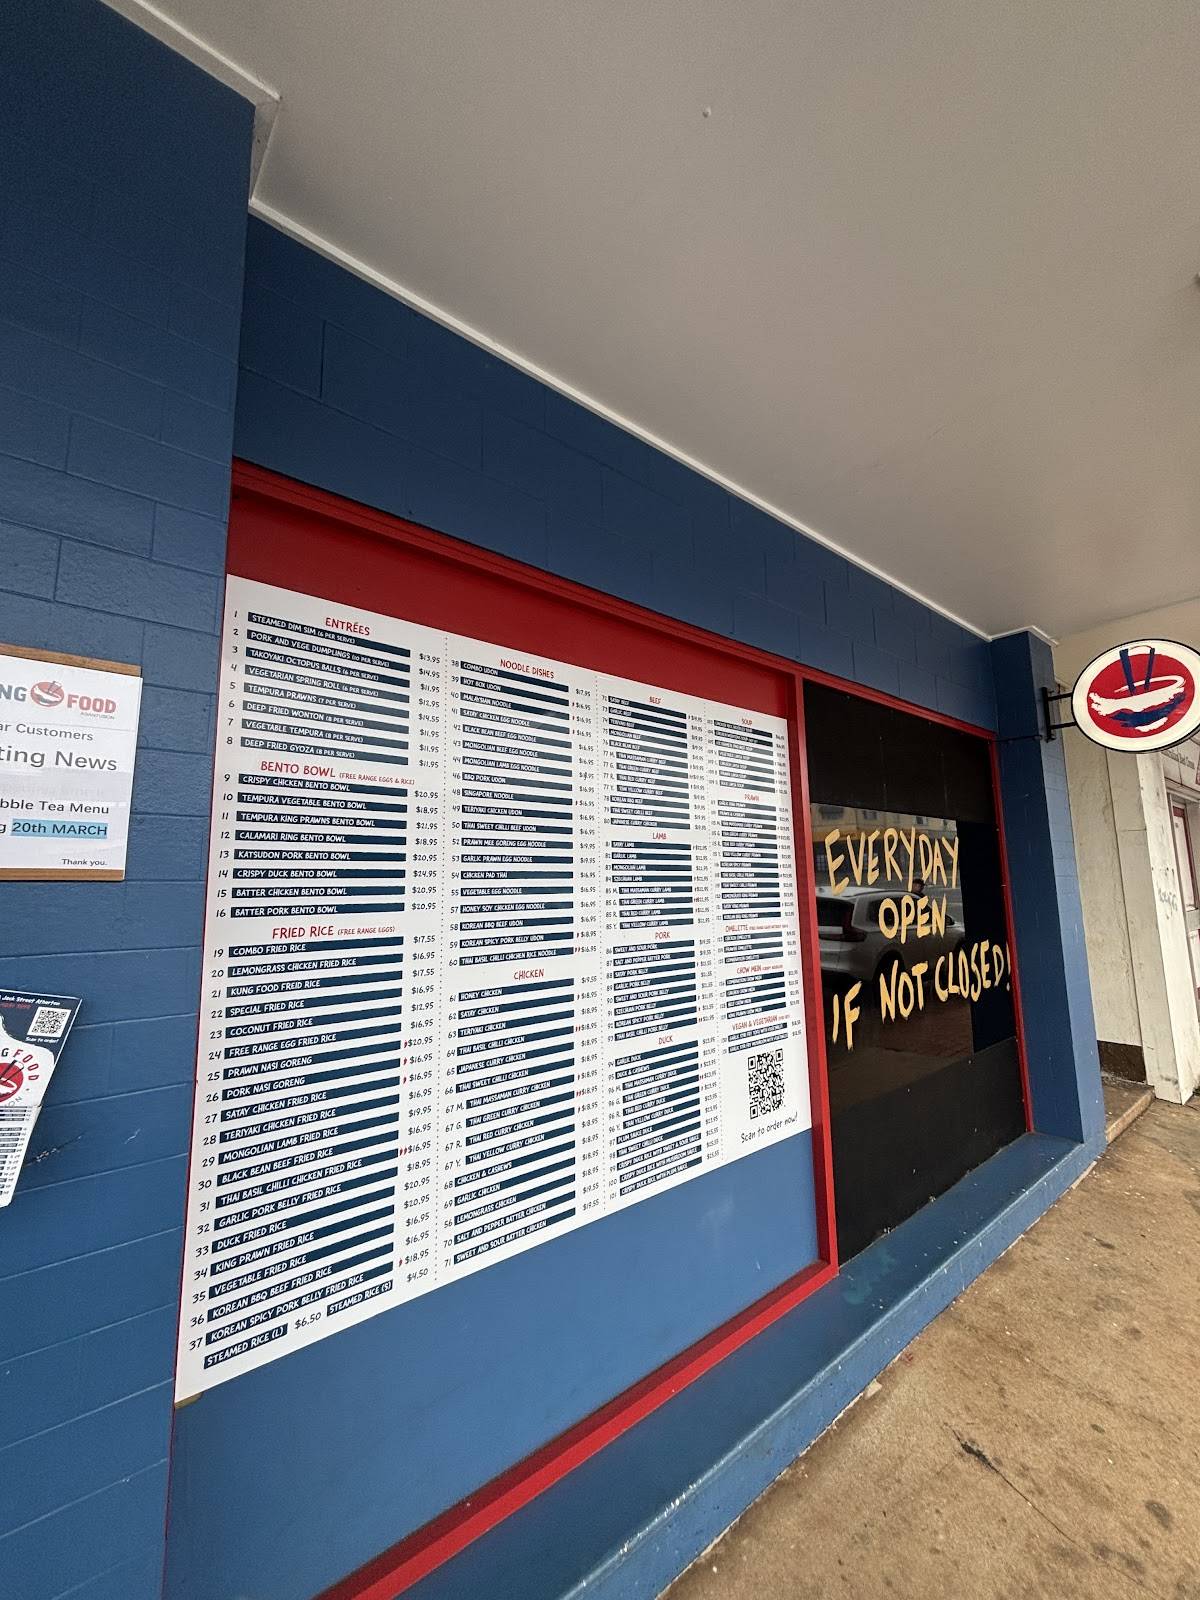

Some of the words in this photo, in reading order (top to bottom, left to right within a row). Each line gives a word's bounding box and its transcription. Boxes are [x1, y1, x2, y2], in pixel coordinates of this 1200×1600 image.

[252, 615, 286, 627] STEAMED
[288, 623, 301, 632] DIM
[304, 627, 316, 635] SIM
[325, 617, 370, 636] ENTRÉES
[500, 659, 530, 674] NOODLE
[532, 667, 554, 678] DISHES
[0, 684, 27, 702] NG
[67, 694, 116, 714] FOOD
[16, 724, 93, 740] Customers
[55, 750, 117, 770] News
[261, 761, 299, 773] BENTO
[304, 766, 335, 777] BOWL
[39, 800, 64, 812] Tea
[70, 803, 109, 814] Menu
[242, 795, 279, 803] TEMPURA
[282, 797, 320, 806] VEGETABLE
[12, 822, 46, 834] 20th
[52, 824, 108, 836] MARCH
[825, 826, 958, 896] EVERYDAY
[879, 895, 946, 944] OPEN
[273, 928, 305, 939] FRIED
[310, 926, 333, 937] RICE
[214, 949, 223, 957] 19
[234, 946, 263, 955] COMBO
[514, 969, 544, 980] CHICKEN
[231, 986, 253, 996] KUNG
[256, 984, 279, 993] FOOD
[281, 982, 302, 990] FREID
[833, 981, 862, 1050] IF
[880, 960, 928, 1024] NOT
[934, 940, 1011, 1002] CLOSED!
[212, 1010, 222, 1018] 22
[230, 1006, 261, 1016] SPECIAL
[264, 1003, 286, 1012] FRIED
[288, 1000, 304, 1009] RICE
[658, 1036, 673, 1044] DUCK
[206, 1093, 218, 1102] 26
[227, 1087, 250, 1098] PORK
[253, 1083, 270, 1093] NASI
[273, 1077, 305, 1089] GORENG
[204, 1135, 216, 1145] 28
[225, 1125, 260, 1140] TERIYAKI
[263, 1118, 295, 1131] CHICKEN
[297, 1113, 318, 1124] FRIED
[320, 1109, 336, 1119] RICE
[741, 1132, 756, 1143] Scan
[758, 1126, 764, 1137] to
[766, 1120, 782, 1132] order
[200, 1202, 210, 1212] 31
[221, 1192, 240, 1204] THAI
[242, 1186, 264, 1199] BASIL
[266, 1179, 290, 1191] CHILLI
[292, 1170, 322, 1184] CHICKEN
[325, 1164, 345, 1176] FRIED
[347, 1159, 362, 1170] RICE
[457, 1192, 476, 1204] GARLIC
[478, 1184, 500, 1196] CHICKEN
[457, 1248, 476, 1262] SWEET
[478, 1244, 489, 1253] AND
[490, 1237, 505, 1248] SOUR
[506, 1229, 525, 1241] BATTER
[526, 1220, 546, 1233] CHICKEN
[193, 1291, 206, 1304] 35
[215, 1271, 261, 1294] VEGETABLE
[264, 1263, 287, 1277] FRIED
[290, 1255, 306, 1268] RICE
[208, 1342, 248, 1366] STEAMED
[251, 1333, 269, 1348] RICE
[272, 1327, 283, 1338] (L)
[295, 1312, 321, 1329] $6.50
[330, 1294, 362, 1313] STEAMED
[365, 1286, 379, 1299] RICE
[382, 1281, 391, 1292] (S)
[407, 1268, 428, 1282] $4.50
